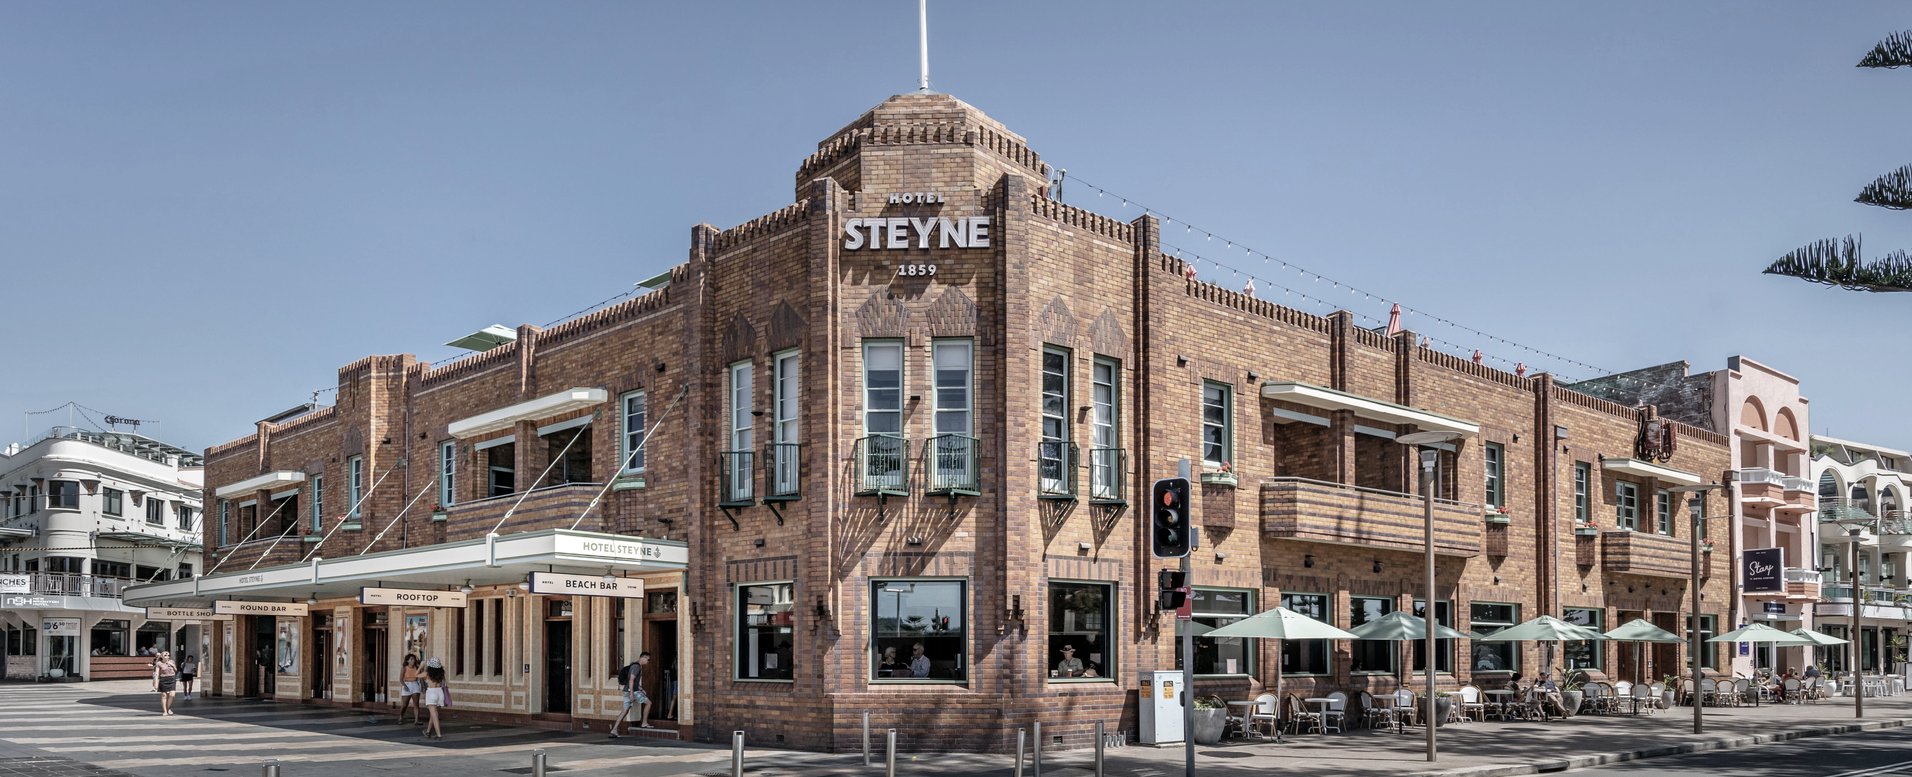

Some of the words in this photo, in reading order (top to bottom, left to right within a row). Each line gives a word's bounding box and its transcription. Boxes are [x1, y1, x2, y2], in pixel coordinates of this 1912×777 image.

[889, 192, 945, 204] HOTEL
[845, 216, 990, 250] STEYNE
[898, 264, 937, 276] 1859
[104, 415, 140, 426] Corona
[583, 542, 615, 553] HOTEL
[617, 545, 652, 556] STEYNE
[1749, 561, 1774, 576] Stay
[565, 580, 597, 589] BEACH
[599, 581, 618, 590] BAR
